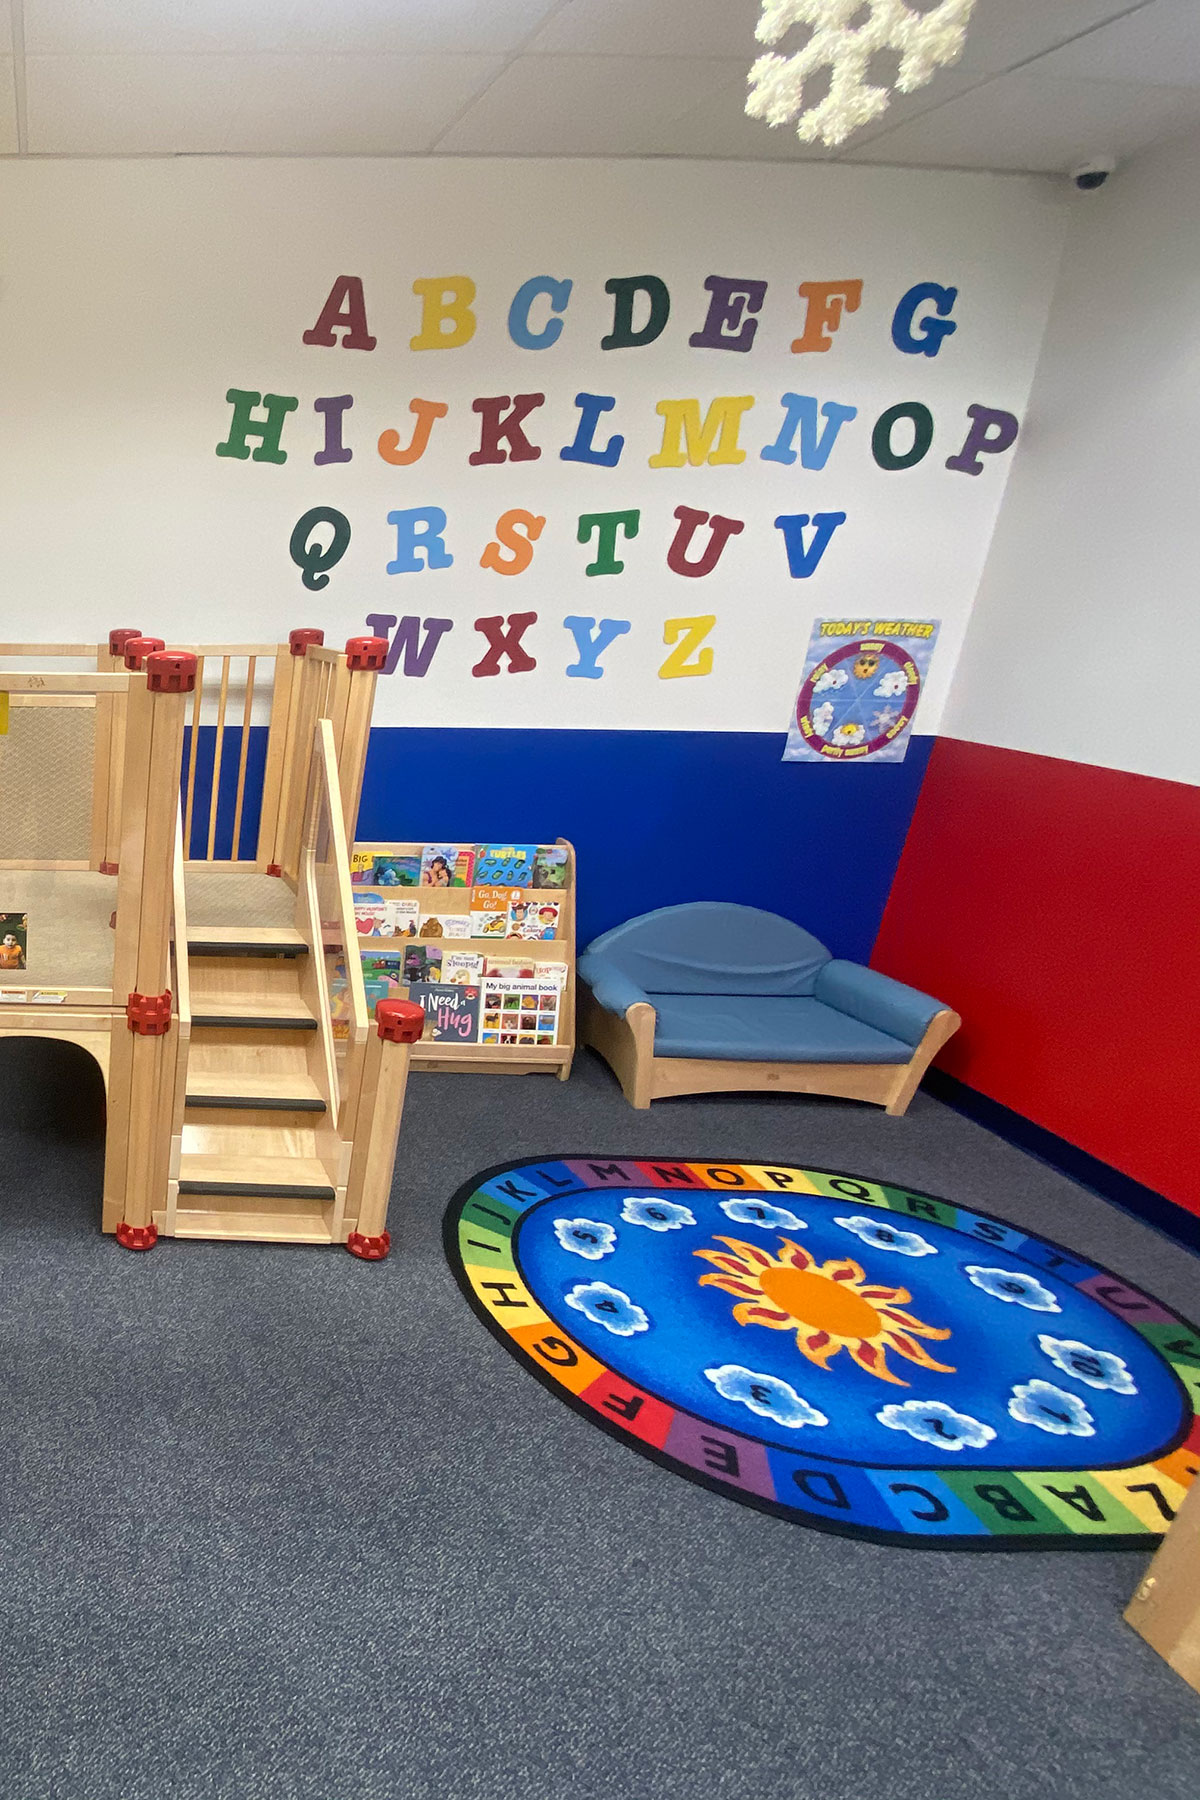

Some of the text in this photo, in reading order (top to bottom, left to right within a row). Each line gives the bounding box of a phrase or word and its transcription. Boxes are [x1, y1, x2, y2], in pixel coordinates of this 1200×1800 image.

[303, 275, 957, 357] A B C D E F G
[216, 389, 1018, 476] H I J K L M N O P
[290, 506, 846, 591] Q R S T U V
[820, 621, 934, 639] TODAY'S WEATHER
[366, 612, 717, 680] W X Y Z
[352, 854, 368, 863] BIG
[485, 982, 497, 991] My
[498, 983, 511, 991] big
[428, 992, 460, 1012] Need
[437, 1007, 472, 1037] Hug
[536, 1169, 573, 1187] L
[587, 1163, 632, 1182] M
[652, 1167, 694, 1184] N
[706, 1168, 745, 1186] O
[764, 1171, 794, 1188] P
[496, 1180, 538, 1203] K
[828, 1179, 875, 1202] Q
[907, 1197, 941, 1220] R
[973, 1221, 1007, 1243] S
[1046, 1249, 1081, 1269] T
[481, 1281, 529, 1308] H
[572, 1206, 1105, 1440] 1 2 3 4 5 6 7 8 9 10
[532, 1336, 579, 1367] G
[603, 1393, 645, 1422] F
[700, 1435, 740, 1478] E
[792, 1469, 851, 1510] D
[889, 1483, 950, 1521] C
[973, 1483, 1037, 1521] B
[1044, 1484, 1106, 1521] A
